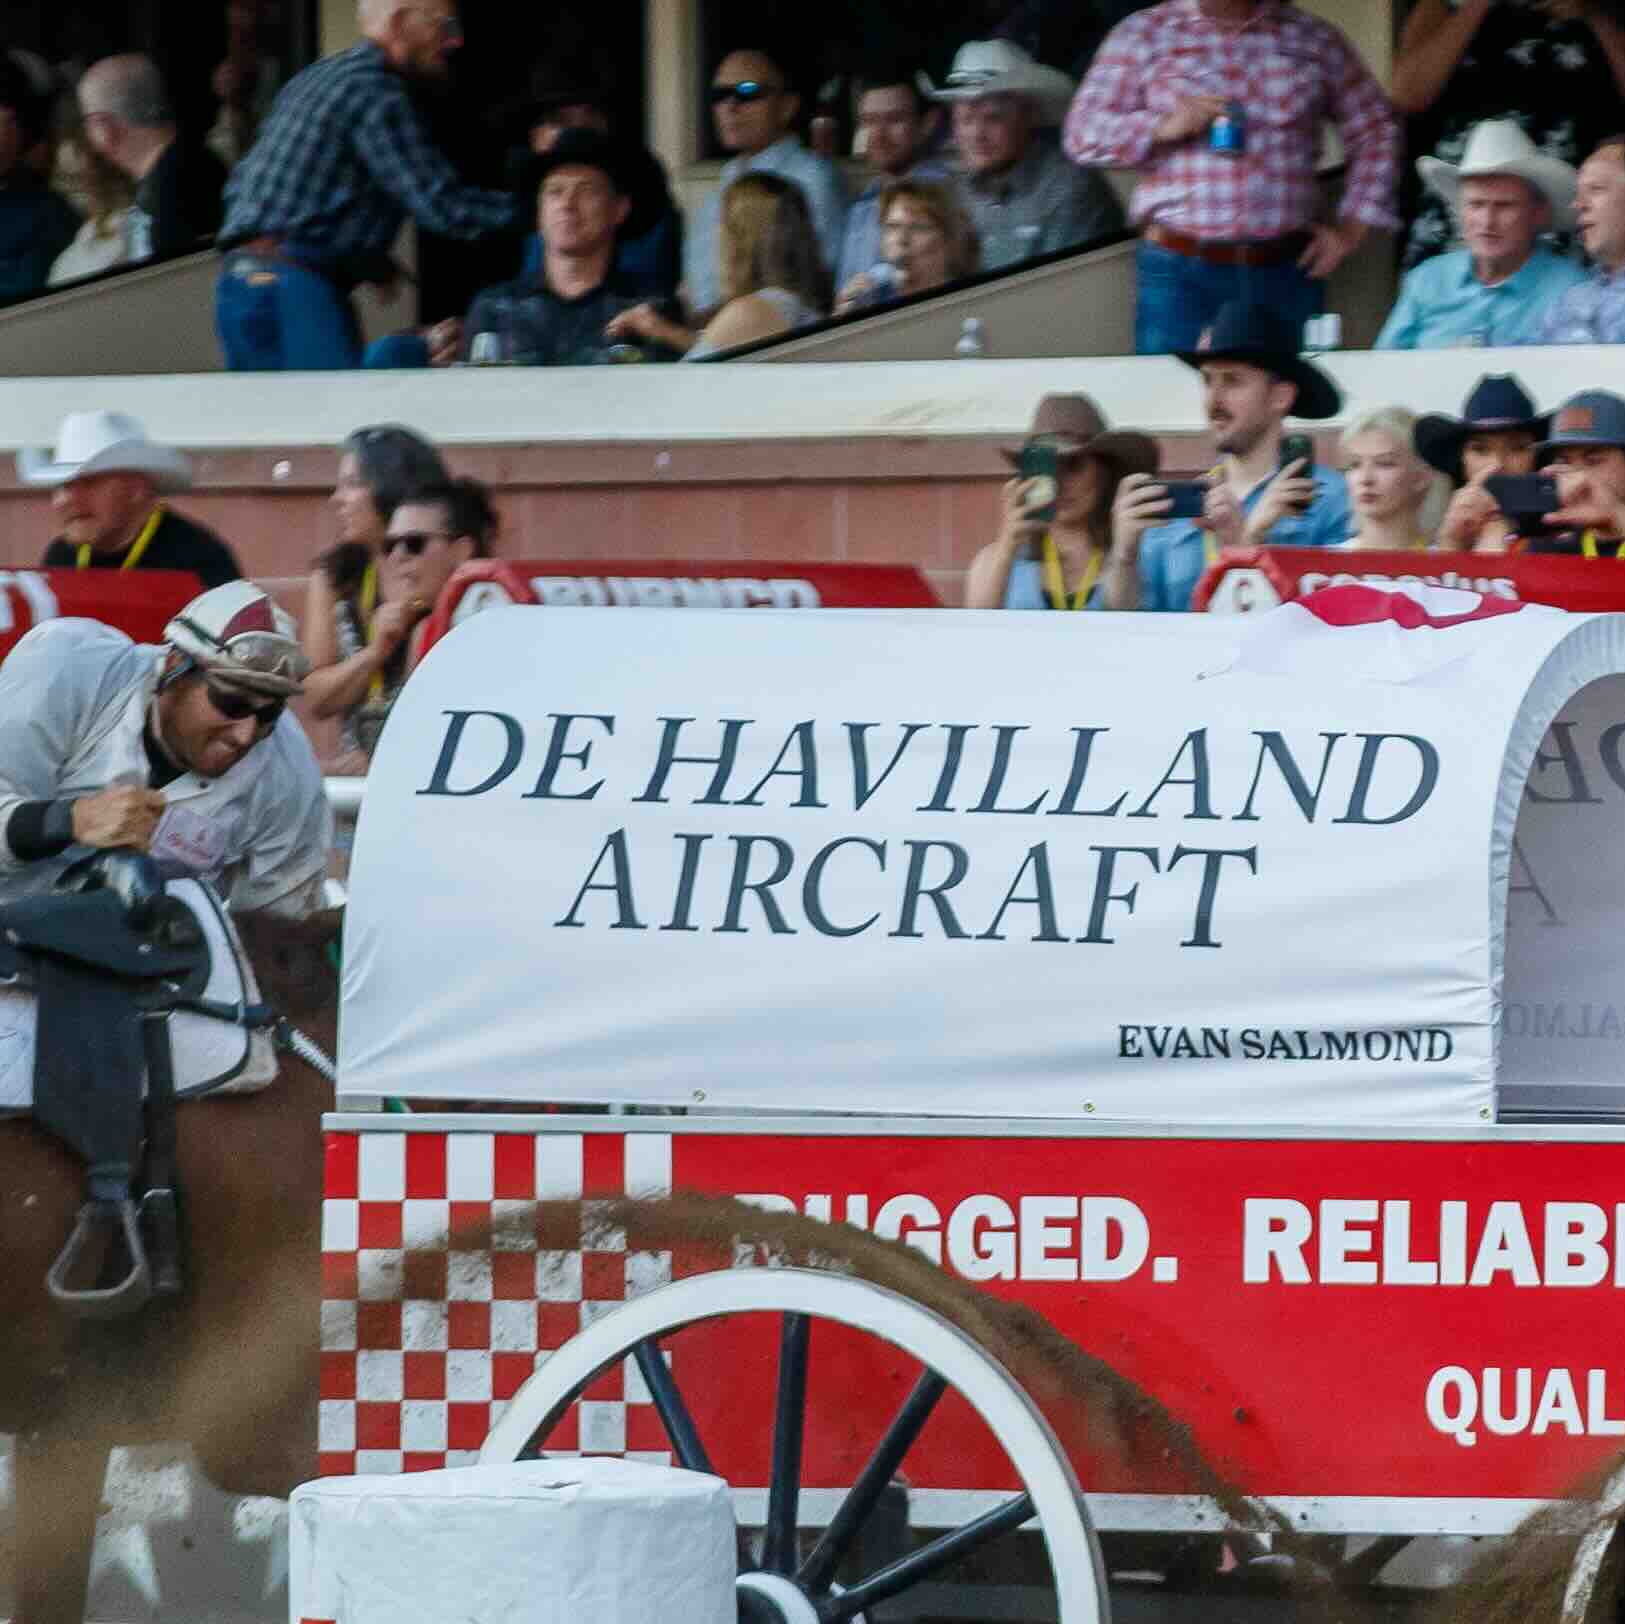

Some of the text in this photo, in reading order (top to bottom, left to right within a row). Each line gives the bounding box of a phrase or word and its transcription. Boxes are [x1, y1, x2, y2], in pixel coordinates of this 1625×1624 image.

[416, 708, 1442, 826] DE HAVILLAND
[553, 826, 1259, 949] AIRCRAFT
[1118, 1025, 1454, 1063] EVAN SALMOND
